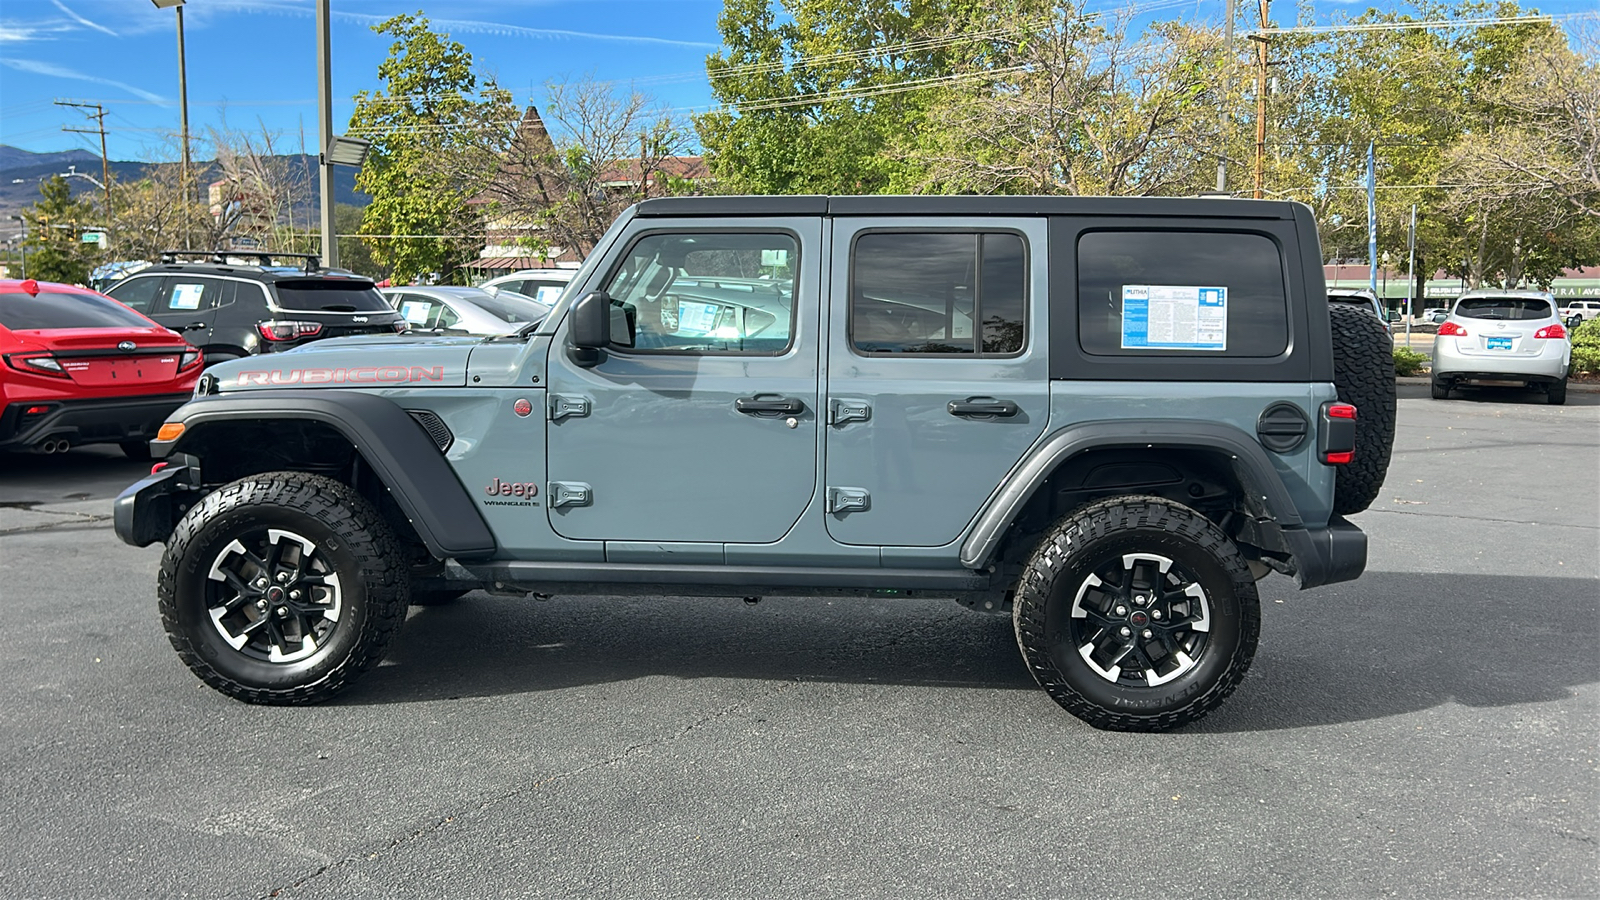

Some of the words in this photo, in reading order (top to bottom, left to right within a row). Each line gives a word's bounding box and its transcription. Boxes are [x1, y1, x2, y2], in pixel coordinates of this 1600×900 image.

[237, 366, 444, 386] RUBICON
[485, 477, 538, 500] Jeep
[1111, 680, 1201, 709] GENERAL
